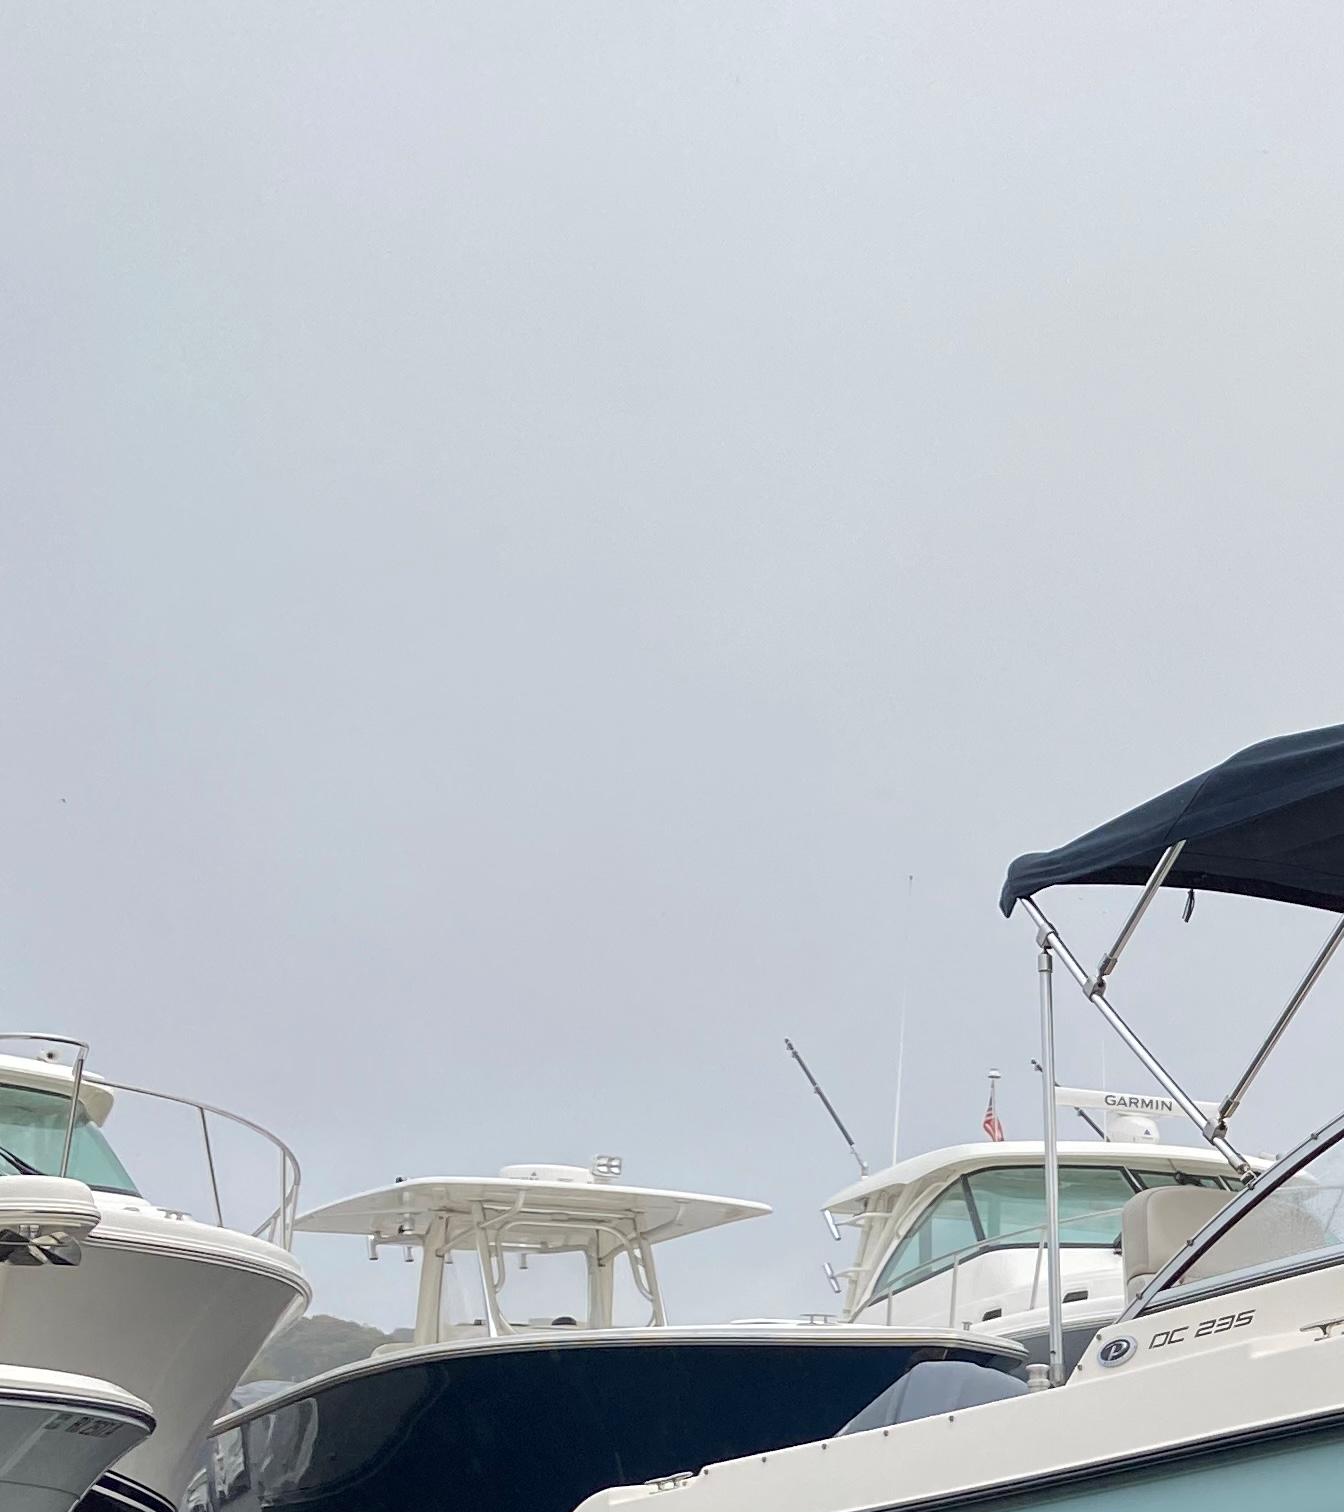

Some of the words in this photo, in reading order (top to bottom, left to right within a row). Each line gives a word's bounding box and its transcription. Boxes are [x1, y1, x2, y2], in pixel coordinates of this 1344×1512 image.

[1104, 1095, 1173, 1111] GARMIN
[1148, 1326, 1189, 1350] DC
[1194, 1309, 1257, 1338] 235
